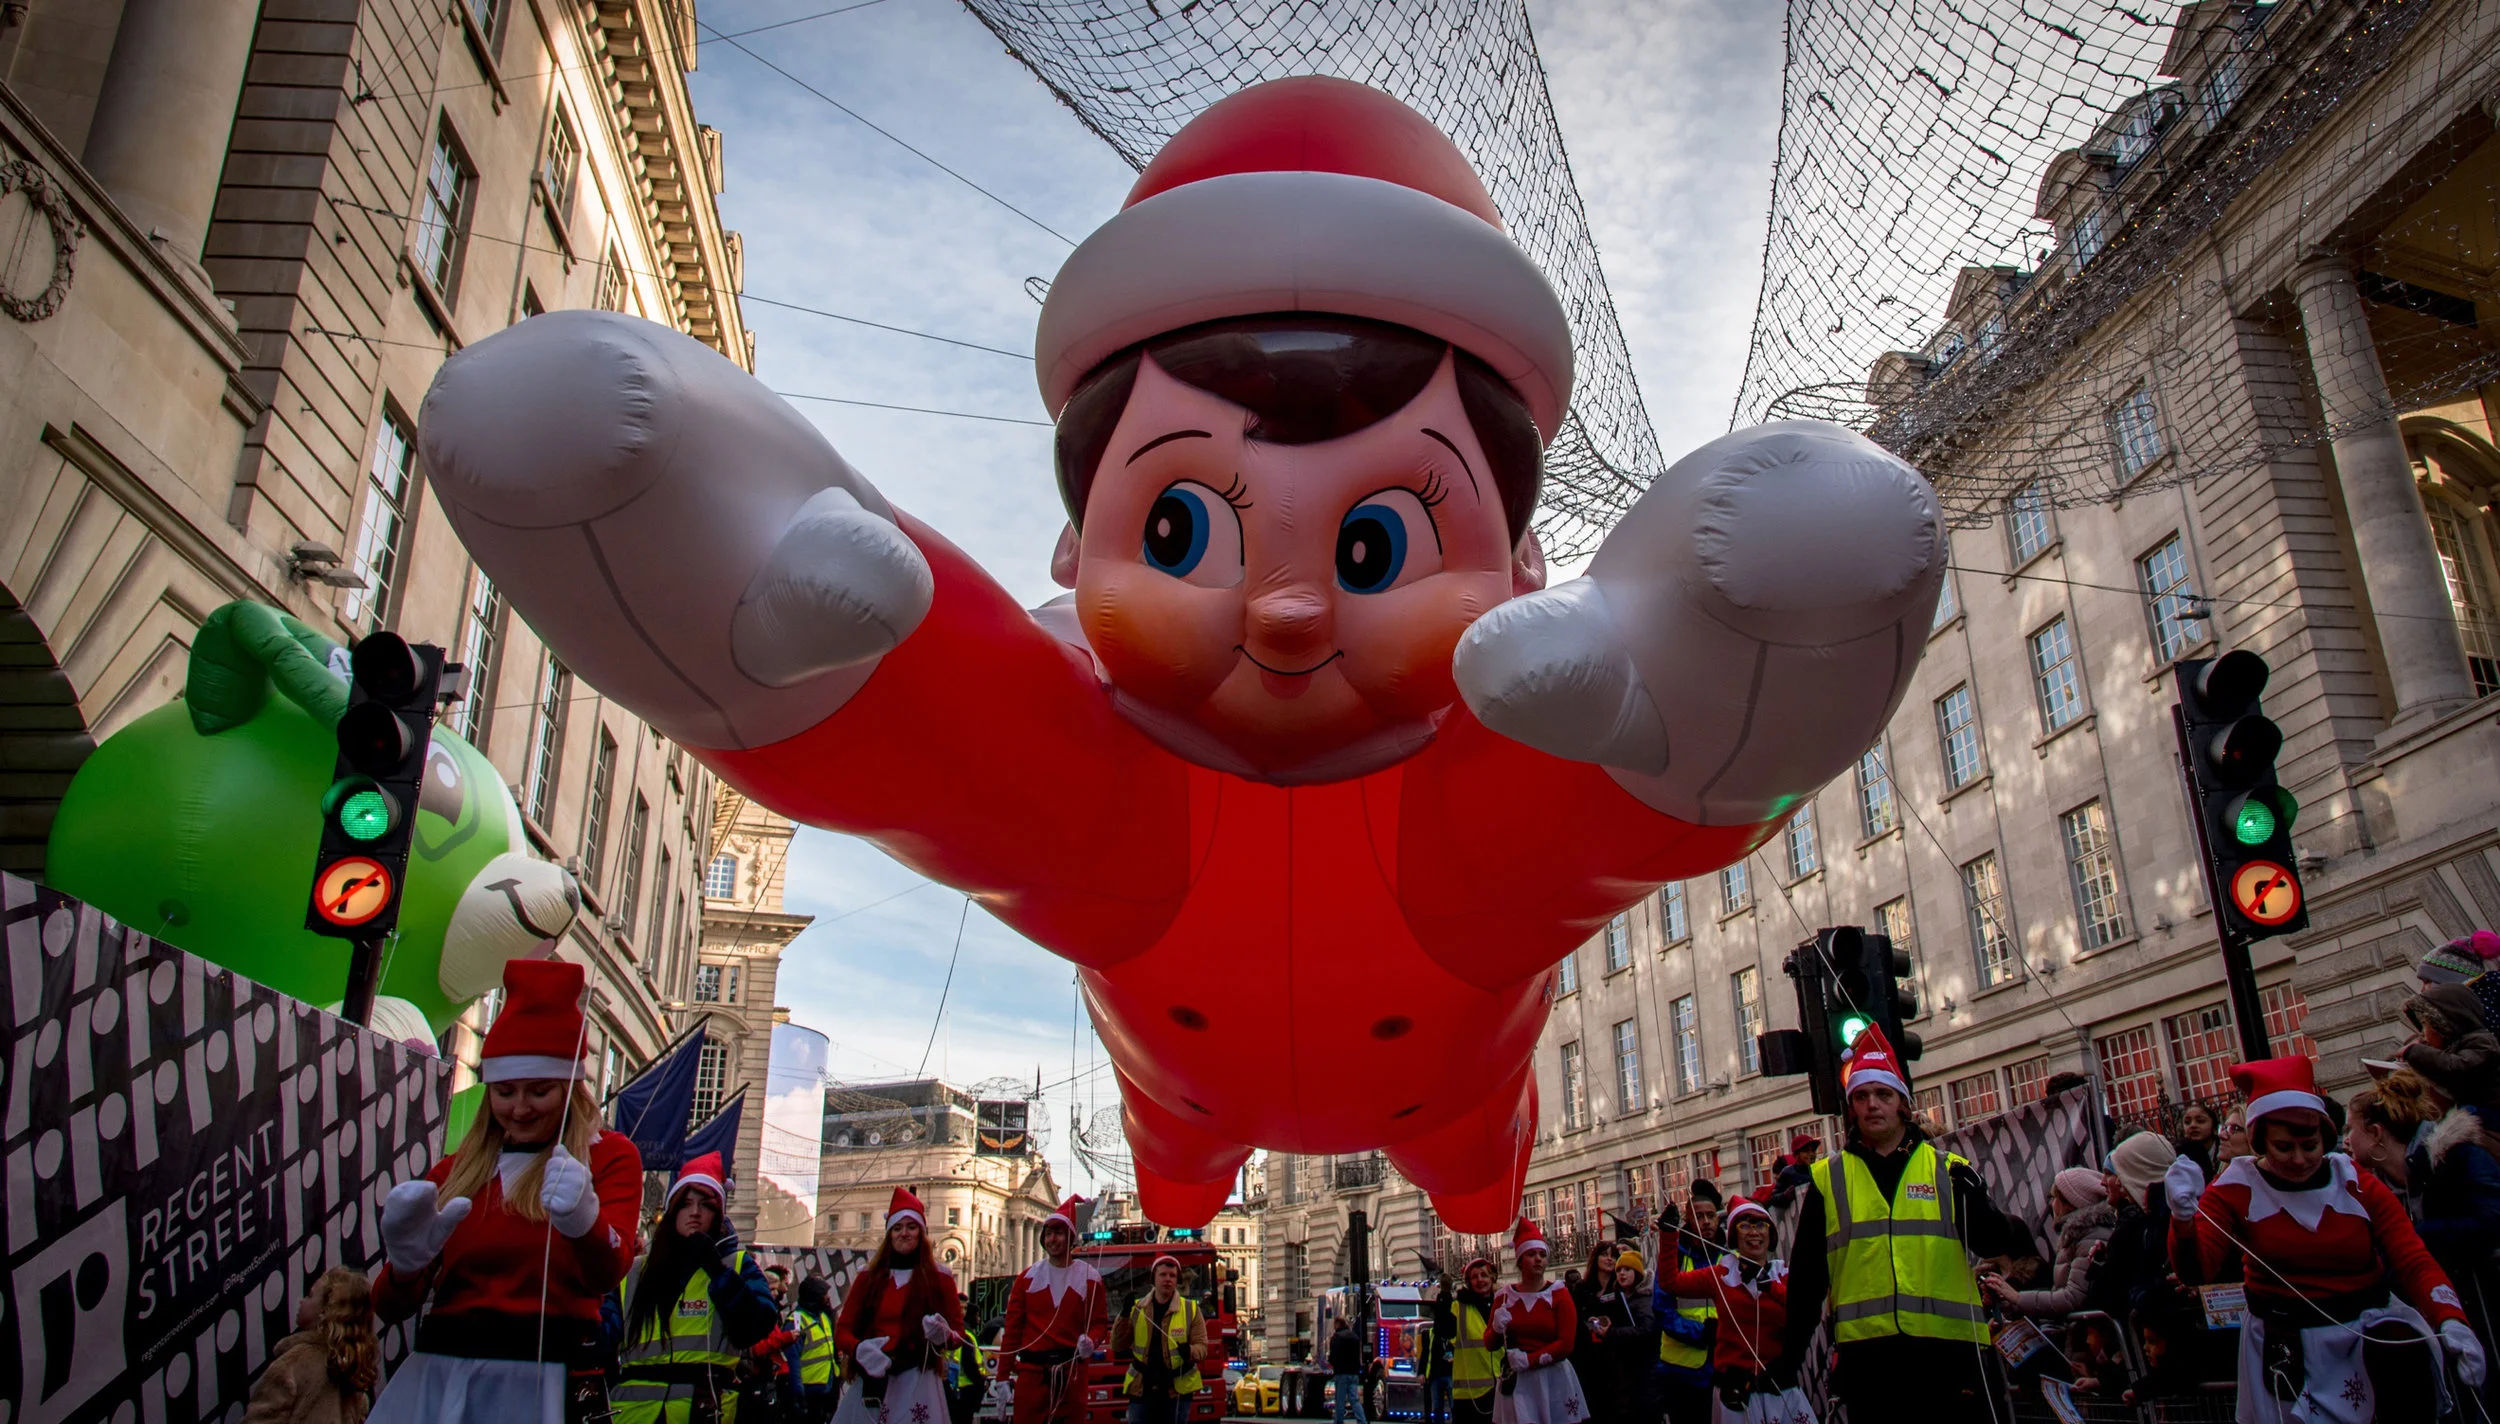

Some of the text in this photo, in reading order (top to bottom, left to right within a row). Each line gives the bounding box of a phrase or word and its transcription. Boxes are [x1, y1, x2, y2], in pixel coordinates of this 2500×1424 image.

[706, 941, 770, 955] FIRE OFFICE
[140, 1119, 274, 1263] REGENT
[1907, 1184, 1936, 1194] mega
[138, 1173, 278, 1320] STREET
[141, 1291, 220, 1363] regentstreetonline.com
